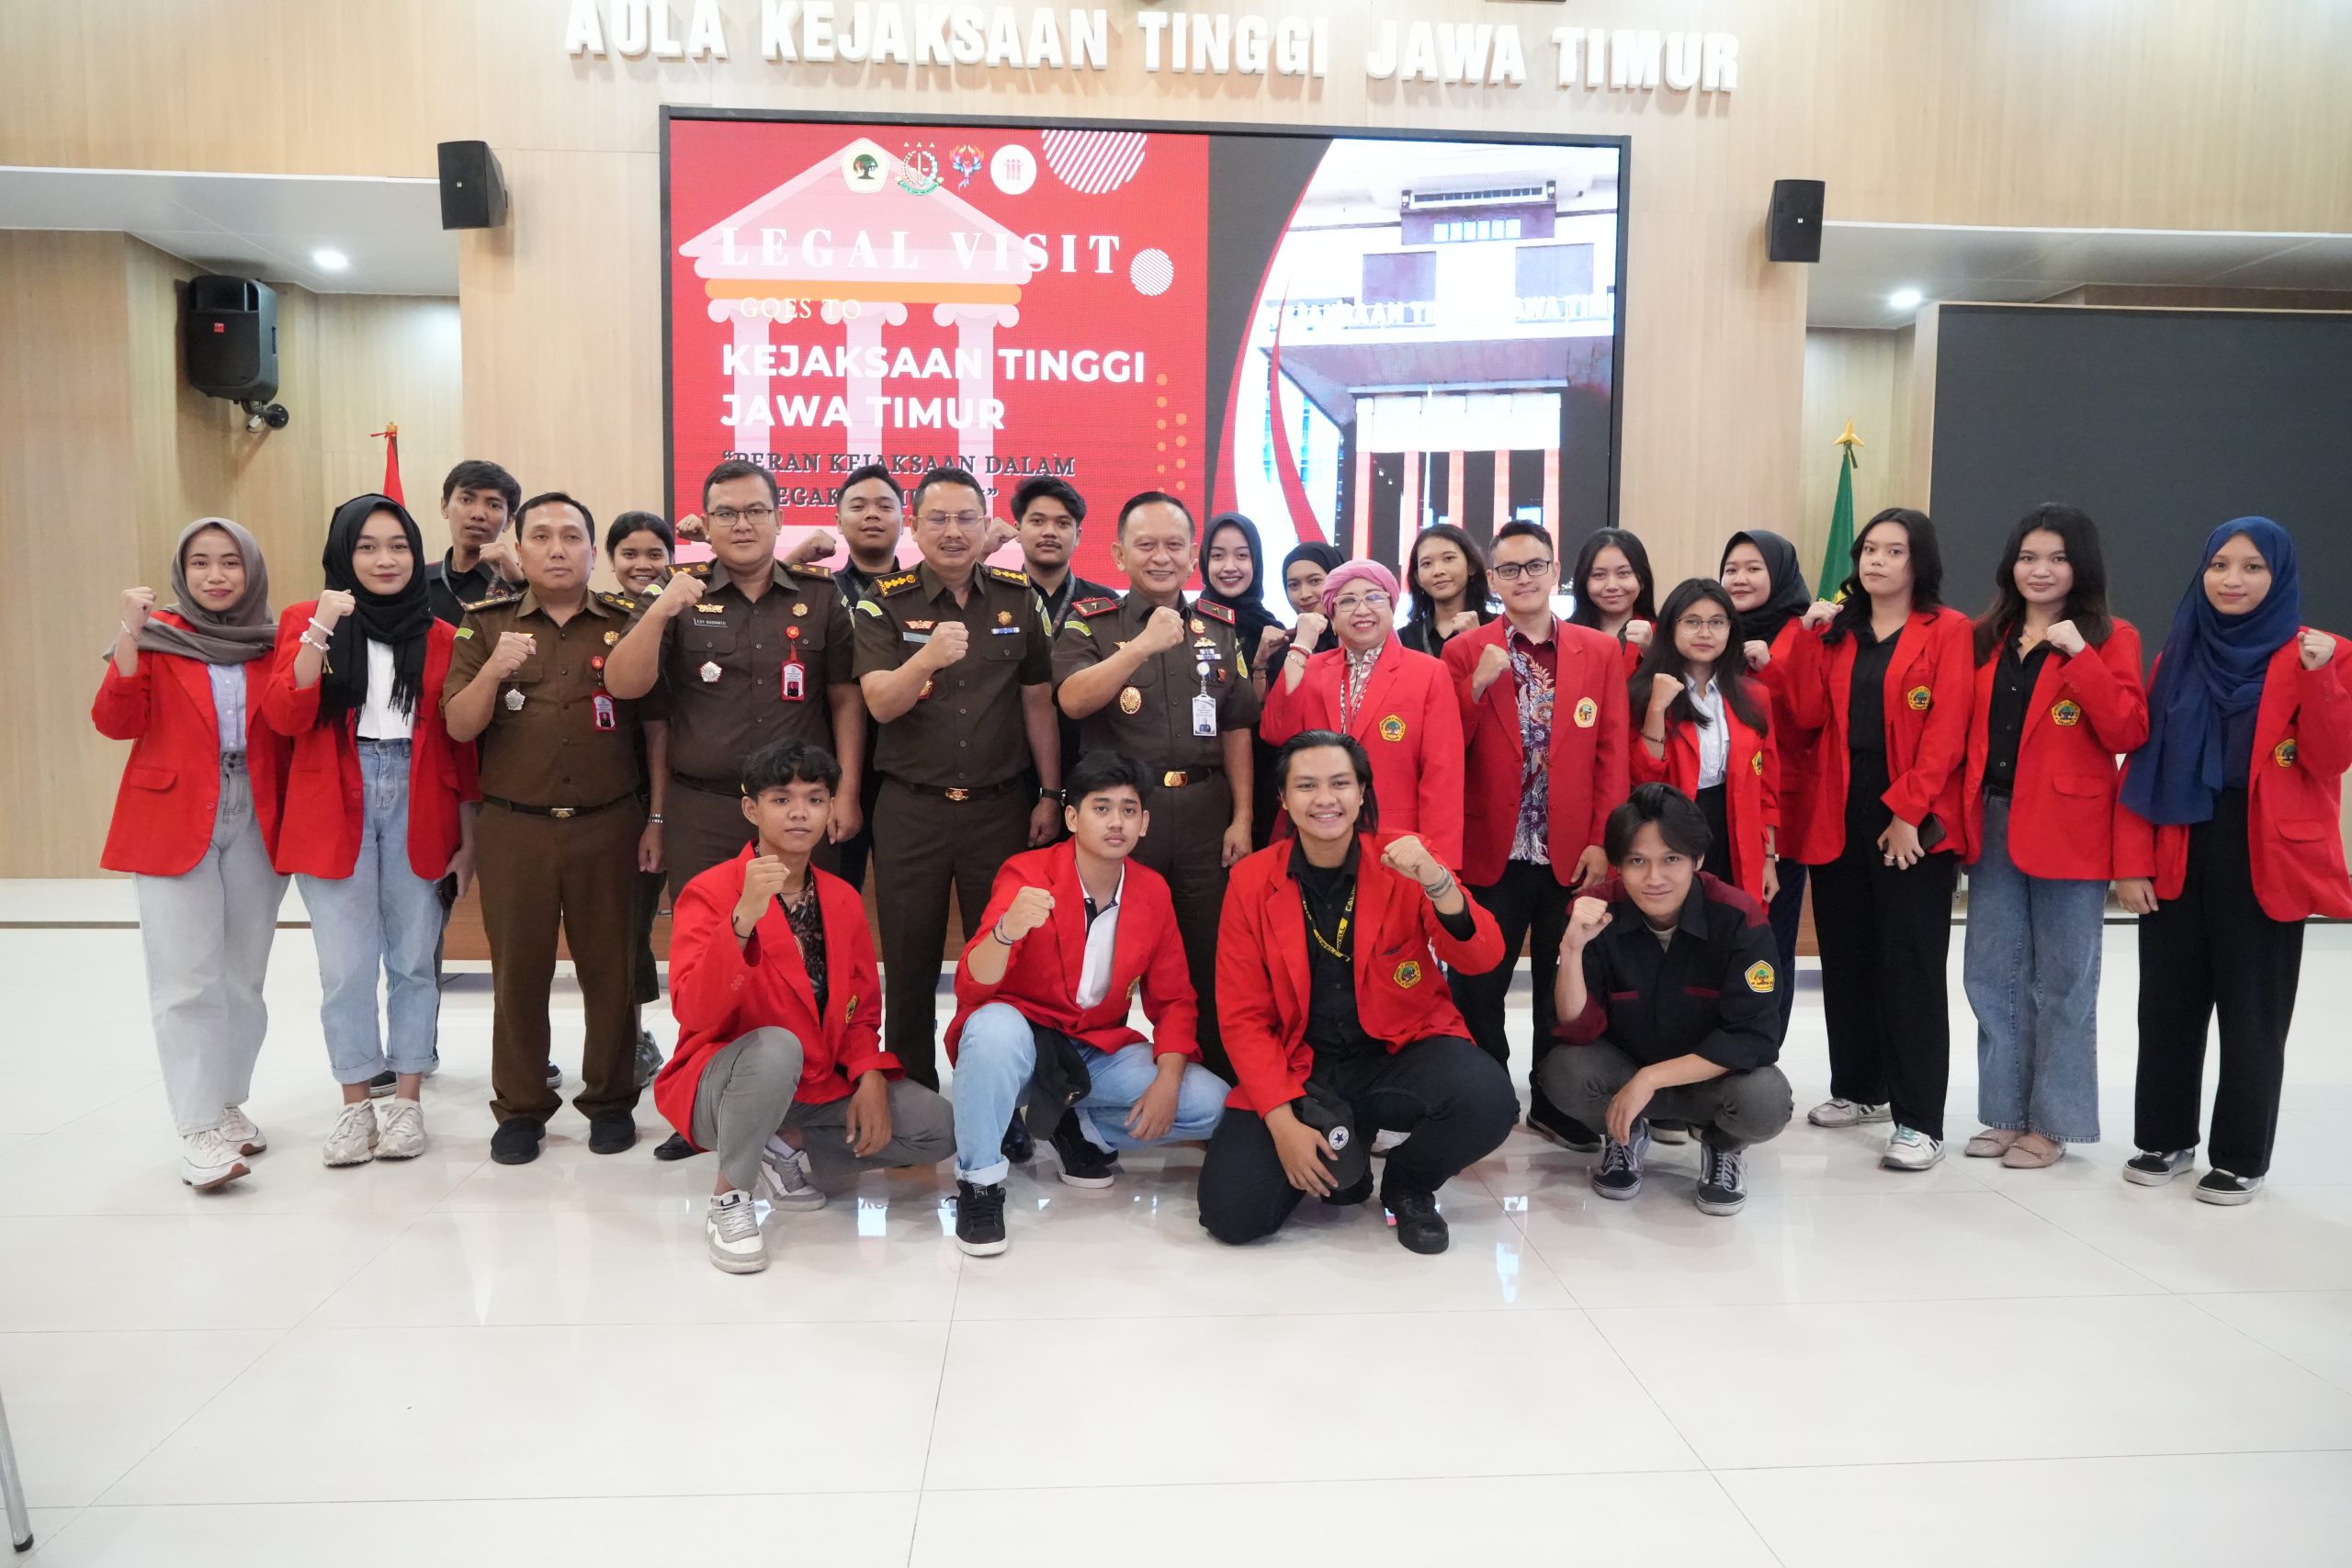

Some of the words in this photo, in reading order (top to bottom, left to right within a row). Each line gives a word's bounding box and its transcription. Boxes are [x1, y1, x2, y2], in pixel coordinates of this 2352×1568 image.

[564, 0, 729, 60] AULA
[761, 0, 1109, 71] KEJAKSAAN
[1138, 11, 1329, 78] TINGGI
[1366, 19, 1526, 85] JAWA
[1553, 27, 1739, 92] TIMUR
[719, 226, 920, 270] LEGAL
[950, 231, 1121, 275] VISIT
[739, 297, 812, 320] GOES
[821, 299, 862, 321] TO
[722, 344, 983, 379] KEJAKSAAN
[998, 348, 1146, 383] TINGGI
[720, 394, 853, 427] JAWA
[866, 396, 1006, 430] TIMUR
[985, 455, 1077, 478] DALAM
